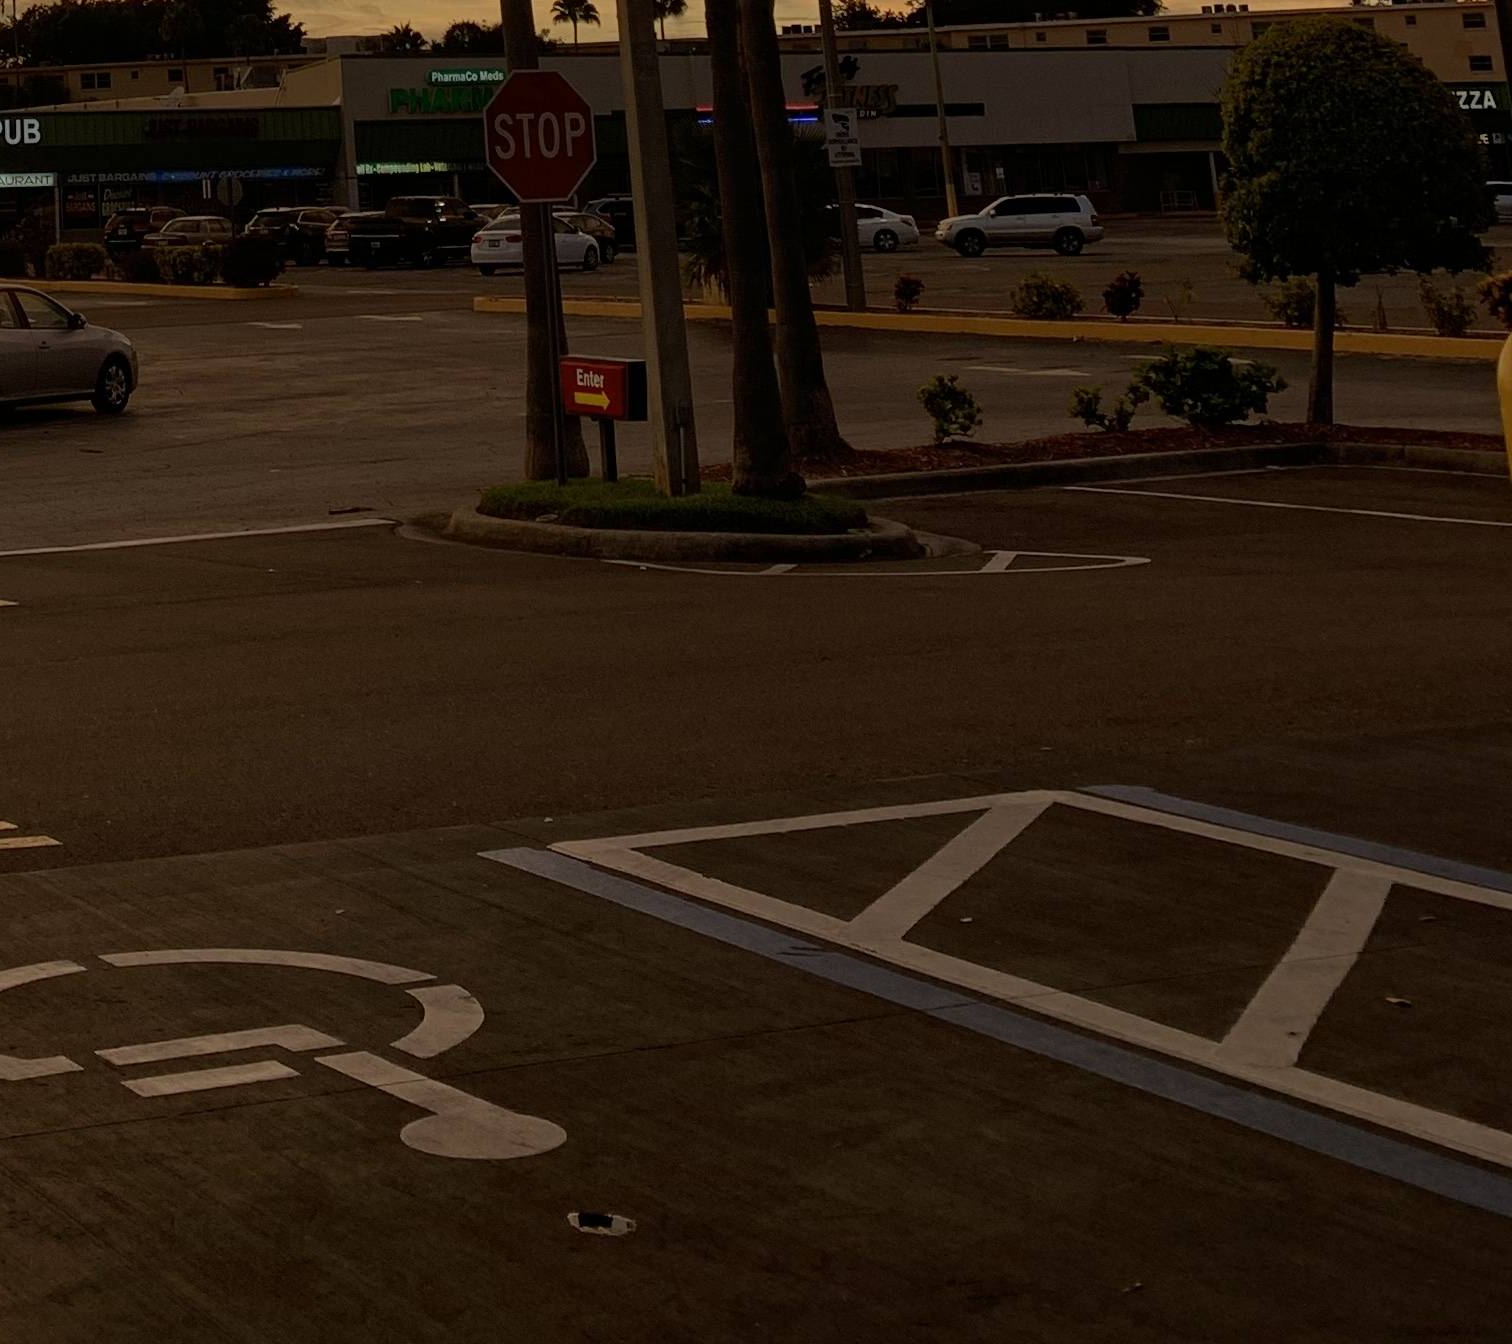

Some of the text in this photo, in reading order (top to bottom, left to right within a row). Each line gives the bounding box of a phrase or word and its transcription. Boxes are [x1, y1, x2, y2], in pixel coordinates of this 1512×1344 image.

[431, 70, 505, 83] PharmaCo Meds
[1451, 89, 1497, 110] ZZA
[494, 111, 586, 160] STOP
[576, 368, 605, 389] Enter
